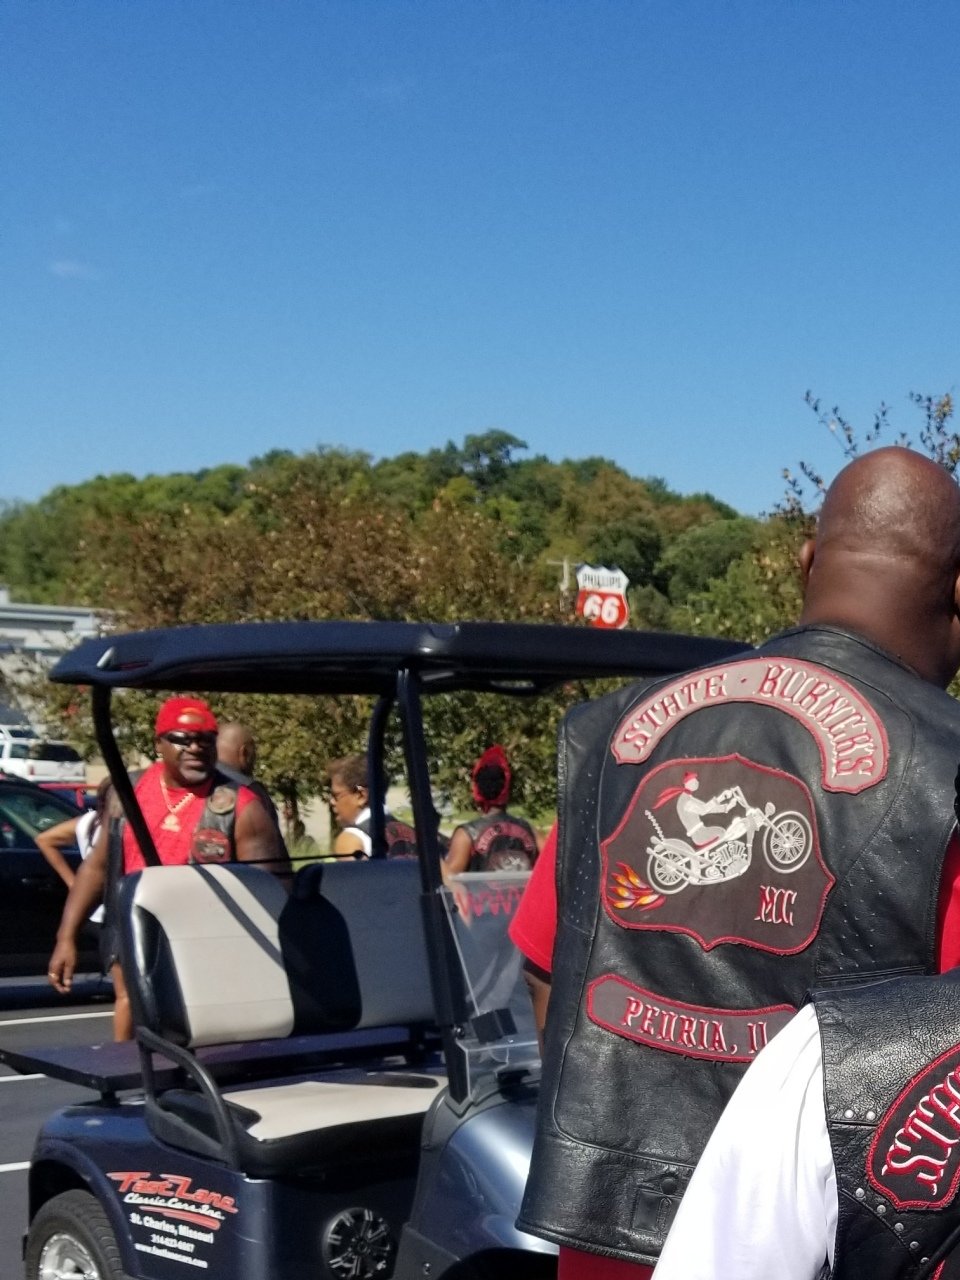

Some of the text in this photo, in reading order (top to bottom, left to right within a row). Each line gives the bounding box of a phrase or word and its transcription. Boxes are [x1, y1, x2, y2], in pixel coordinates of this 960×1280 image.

[583, 594, 621, 624] 66
[622, 671, 728, 754] STATE
[754, 885, 798, 926] MC
[123, 1192, 167, 1207] Classic
[160, 1173, 239, 1214] Lane
[129, 1212, 142, 1226] St.
